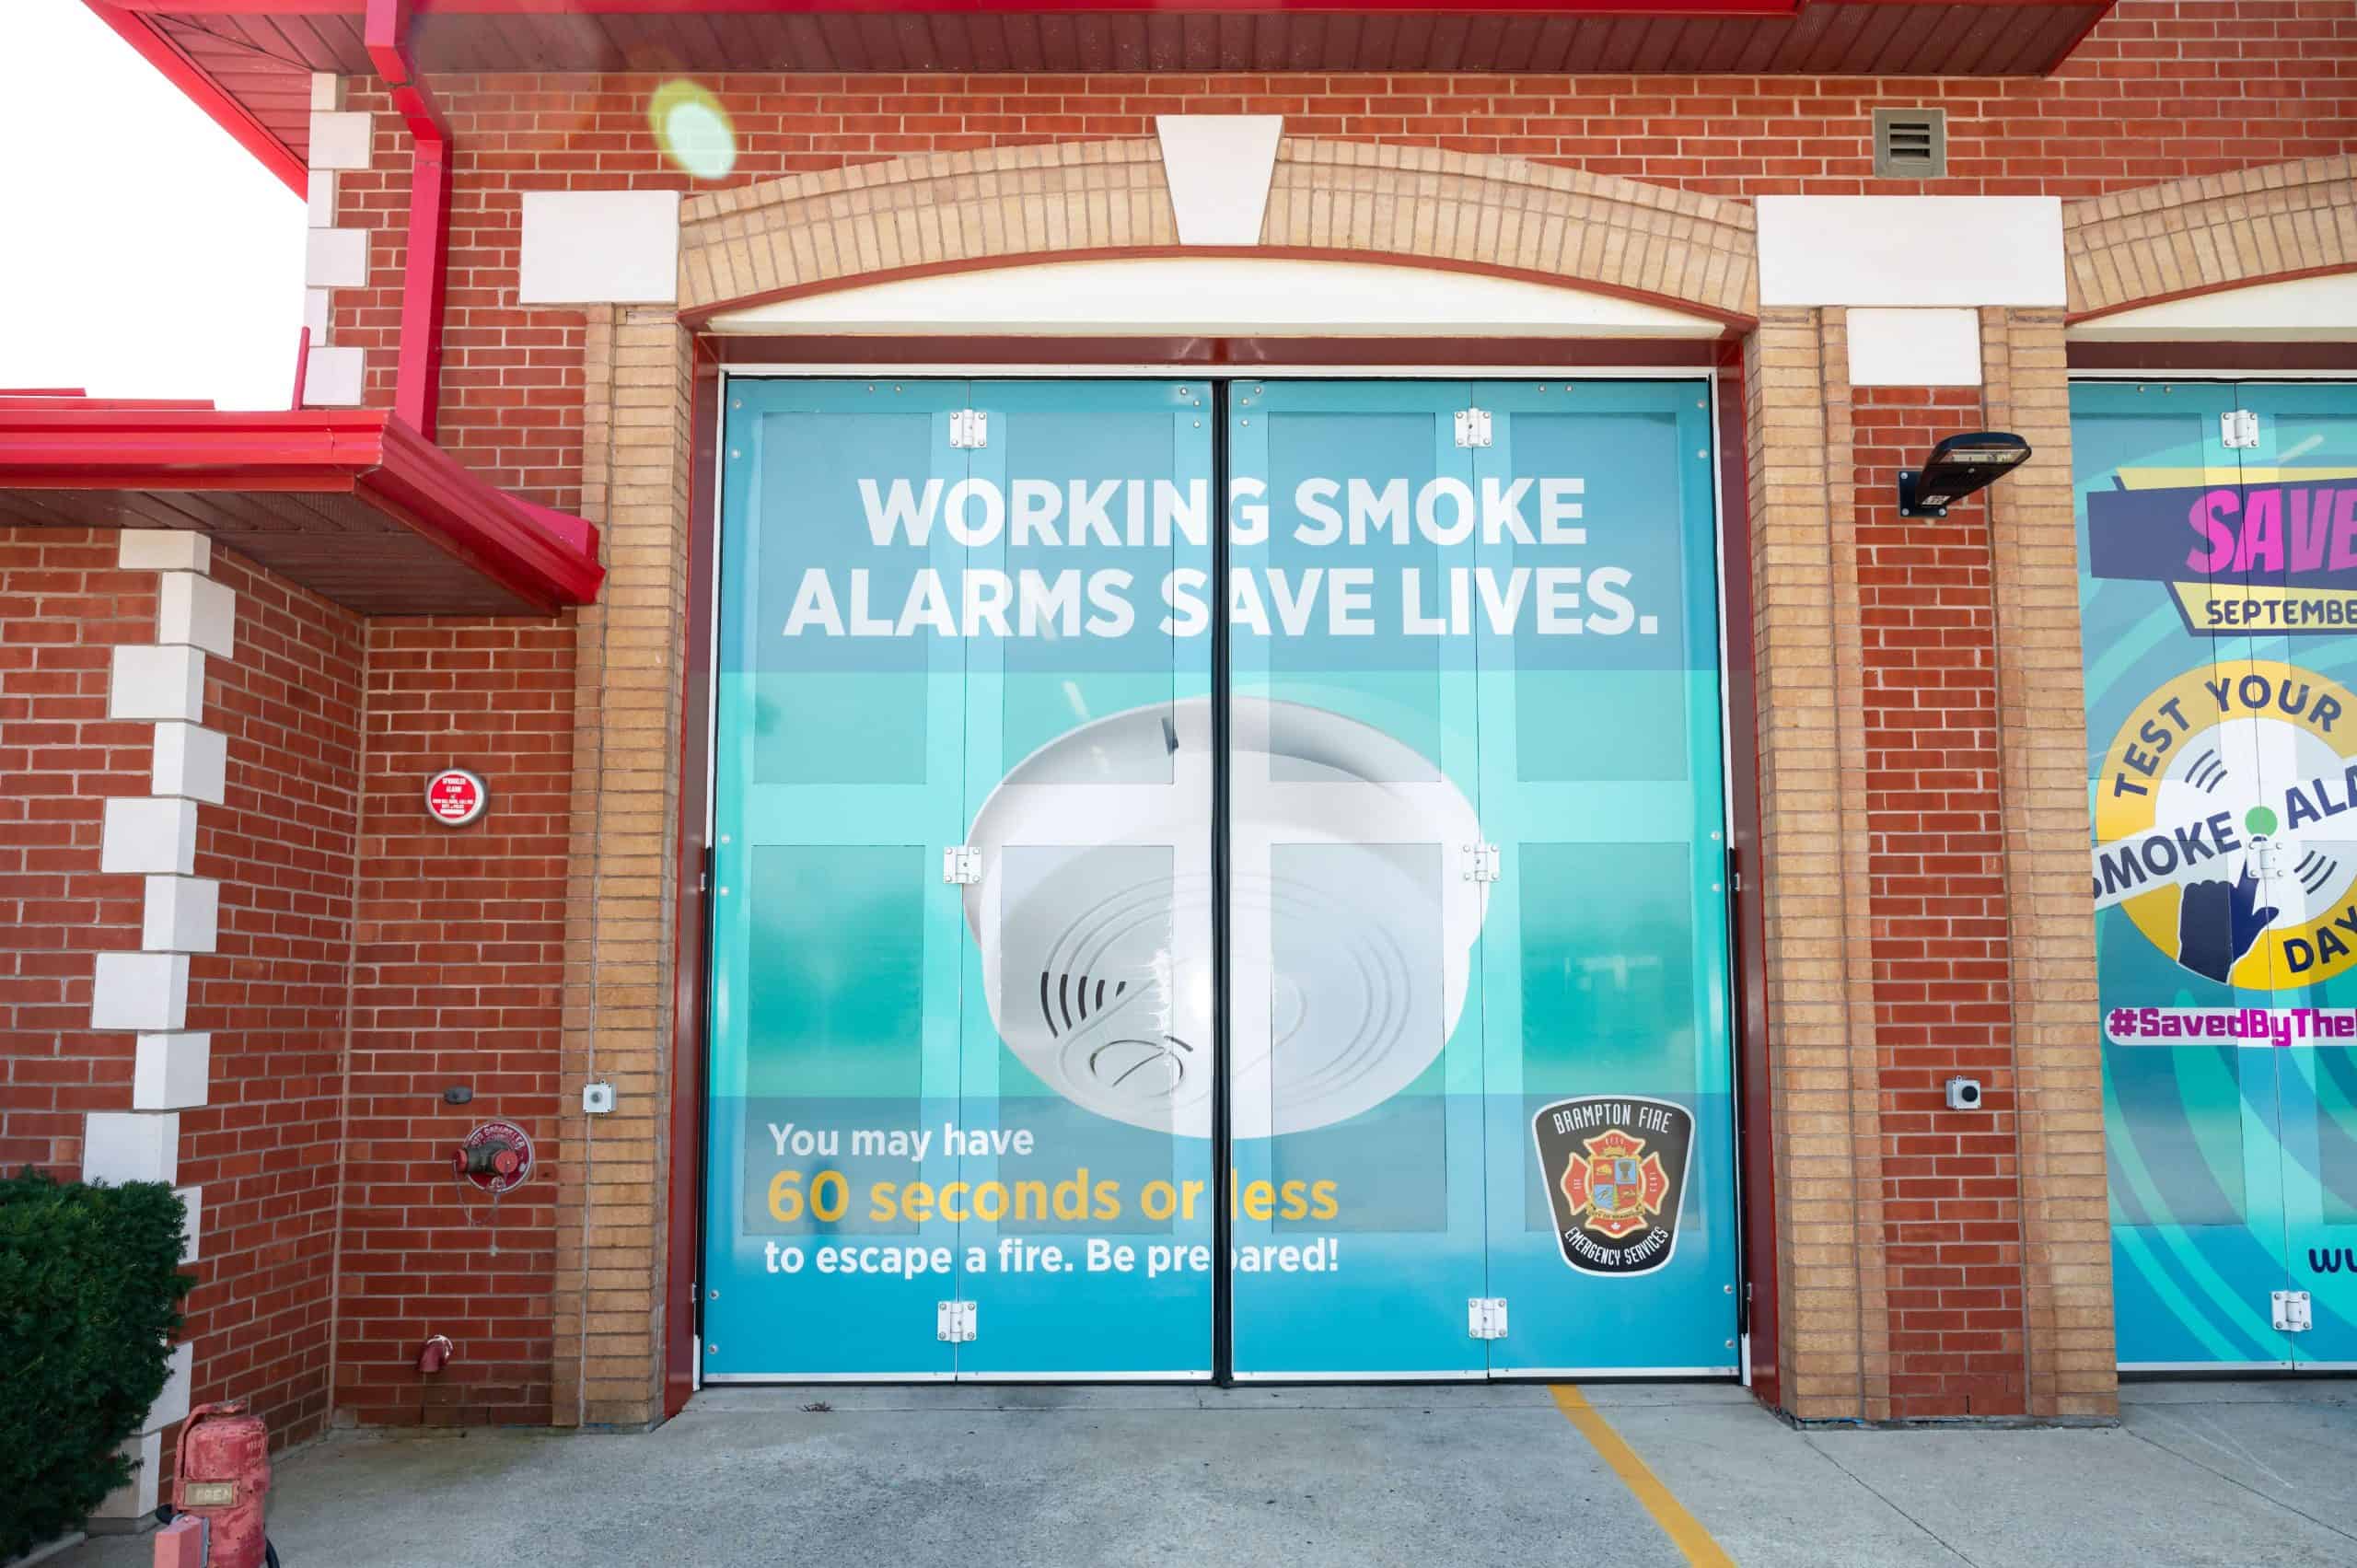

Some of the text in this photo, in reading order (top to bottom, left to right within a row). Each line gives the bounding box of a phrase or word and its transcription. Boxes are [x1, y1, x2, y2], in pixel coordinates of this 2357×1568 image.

[858, 477, 1587, 547] WORKING SMOKE
[783, 566, 1658, 637] ALARMS SAVE LIVES.
[2114, 674, 2342, 798] TEST YOUR
[2092, 810, 2243, 900] MOKE
[2282, 905, 2357, 974] DAY
[2108, 1007, 2357, 1047] #SavedByThe
[768, 1122, 1035, 1162] You may have
[1552, 1103, 1673, 1135] BRAMPTON FIRE
[767, 1168, 850, 1223] 60
[868, 1167, 1121, 1222] seconds
[1140, 1179, 1204, 1222] or
[764, 1237, 1339, 1280] to escape a fire. Be preared!
[1564, 1225, 1669, 1267] EMERGENCY SERVICES
